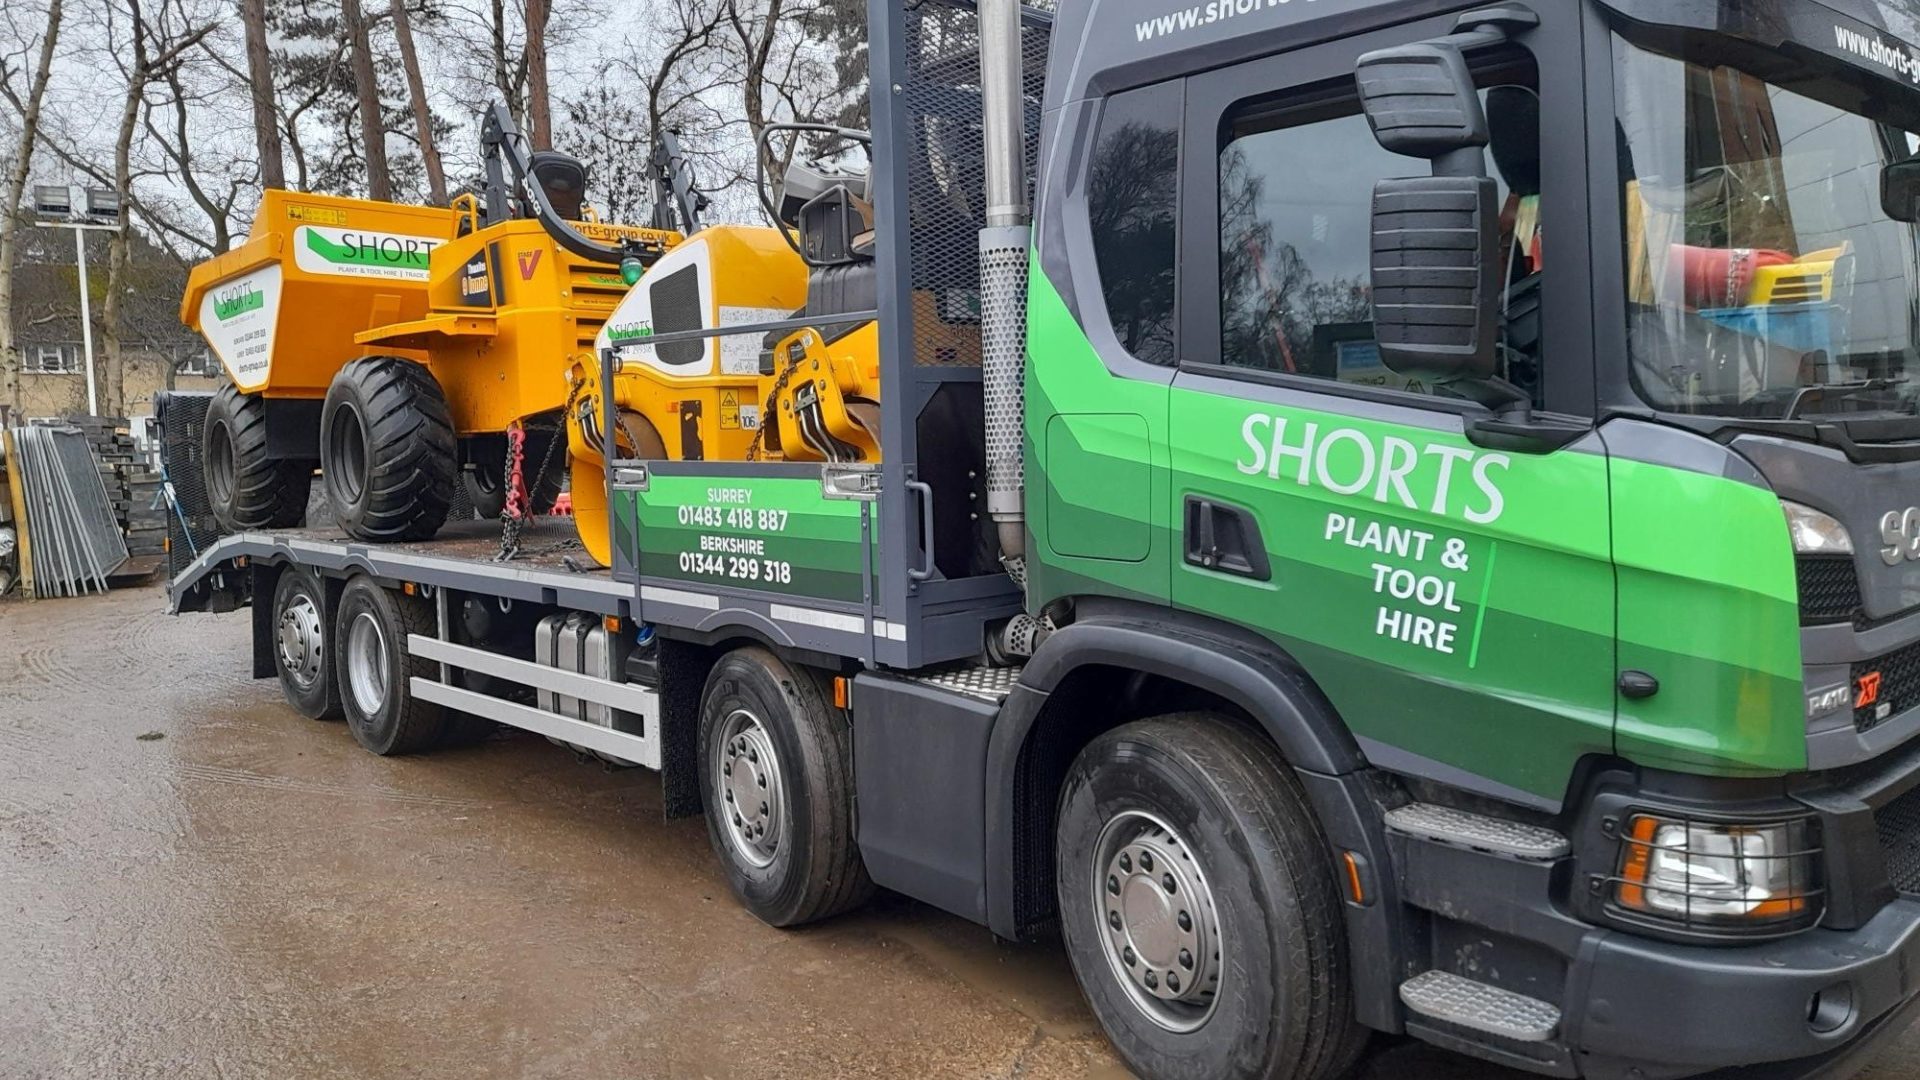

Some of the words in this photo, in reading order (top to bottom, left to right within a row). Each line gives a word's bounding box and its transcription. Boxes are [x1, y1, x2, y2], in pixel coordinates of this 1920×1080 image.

[342, 233, 438, 264] SHORT
[338, 266, 357, 274] PLANT
[221, 281, 254, 315] SHORTS
[615, 320, 650, 340] SHORTS
[742, 416, 756, 428] 106
[1236, 412, 1511, 525] SHORTS
[707, 487, 753, 504] SURREY
[678, 504, 722, 528] 01483
[727, 509, 753, 529] 418
[758, 510, 788, 531] 887
[700, 535, 765, 556] BERKSHIRE
[1324, 512, 1434, 561] PLANT
[1440, 537, 1469, 572] &
[1880, 507, 1920, 566] SC
[679, 552, 725, 576] 01344
[729, 557, 758, 580] 299
[763, 560, 791, 584] 318
[1371, 563, 1462, 612] TOOL
[1376, 606, 1458, 654] HIRE
[1855, 672, 1881, 709] XT
